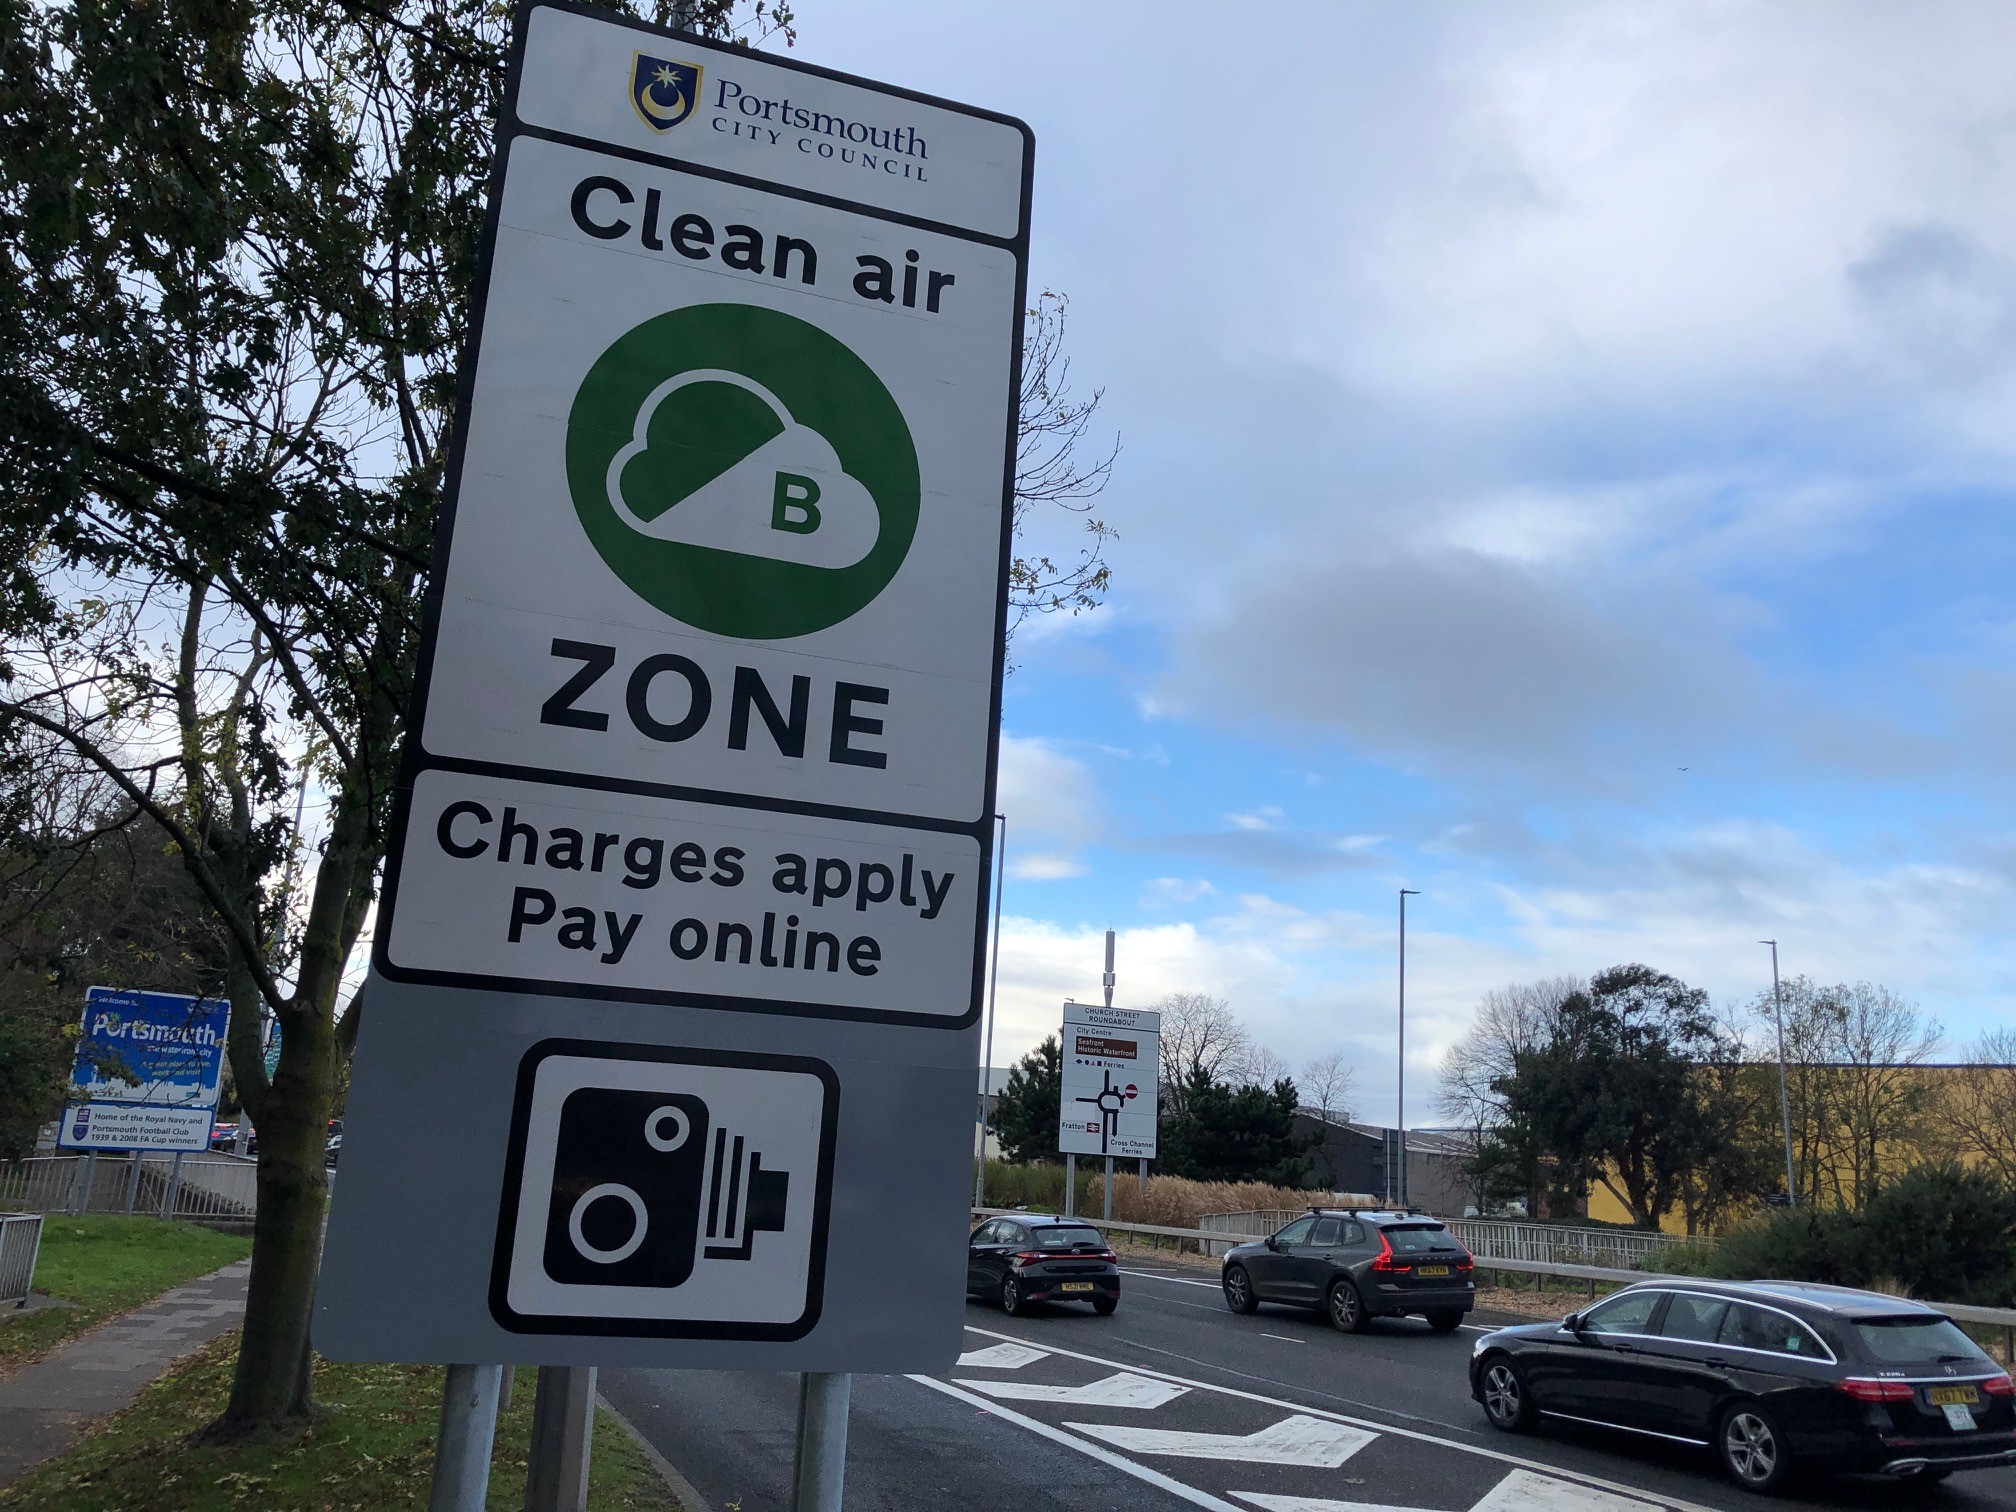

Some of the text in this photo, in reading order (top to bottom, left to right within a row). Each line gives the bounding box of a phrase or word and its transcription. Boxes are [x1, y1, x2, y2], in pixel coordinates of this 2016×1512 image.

[714, 79, 929, 160] Portsmouth
[712, 117, 929, 182] CITY COUNCIL
[570, 176, 956, 314] Clean air
[771, 471, 822, 535] B
[540, 638, 890, 769] ZONE
[437, 801, 955, 919] Charges apply
[507, 886, 882, 976] Pay online
[1084, 1007, 1140, 1019] CHURCH STREET
[1089, 1015, 1136, 1026] ROUNDABOUT
[92, 1012, 216, 1046] Portsmouth
[1076, 1026, 1112, 1036] City Centre
[1077, 1038, 1104, 1047] Seafront
[199, 1048, 213, 1058] city
[1103, 1048, 1136, 1057] Waterfront
[1103, 1061, 1125, 1069] Ferries
[94, 1113, 118, 1121] Home
[120, 1113, 129, 1121] of
[130, 1114, 143, 1122] the
[145, 1115, 167, 1125] Royal
[168, 1117, 187, 1126] Navy
[188, 1117, 203, 1125] and
[92, 1124, 189, 1136] Portsmouth Football Club
[1061, 1122, 1085, 1130] Fratton
[119, 1135, 138, 1143] 2008
[140, 1135, 150, 1143] FA
[151, 1136, 167, 1144] Cup
[168, 1136, 198, 1145] winners
[1110, 1139, 1154, 1149] Cross Channel
[1121, 1147, 1143, 1155] Ferries
